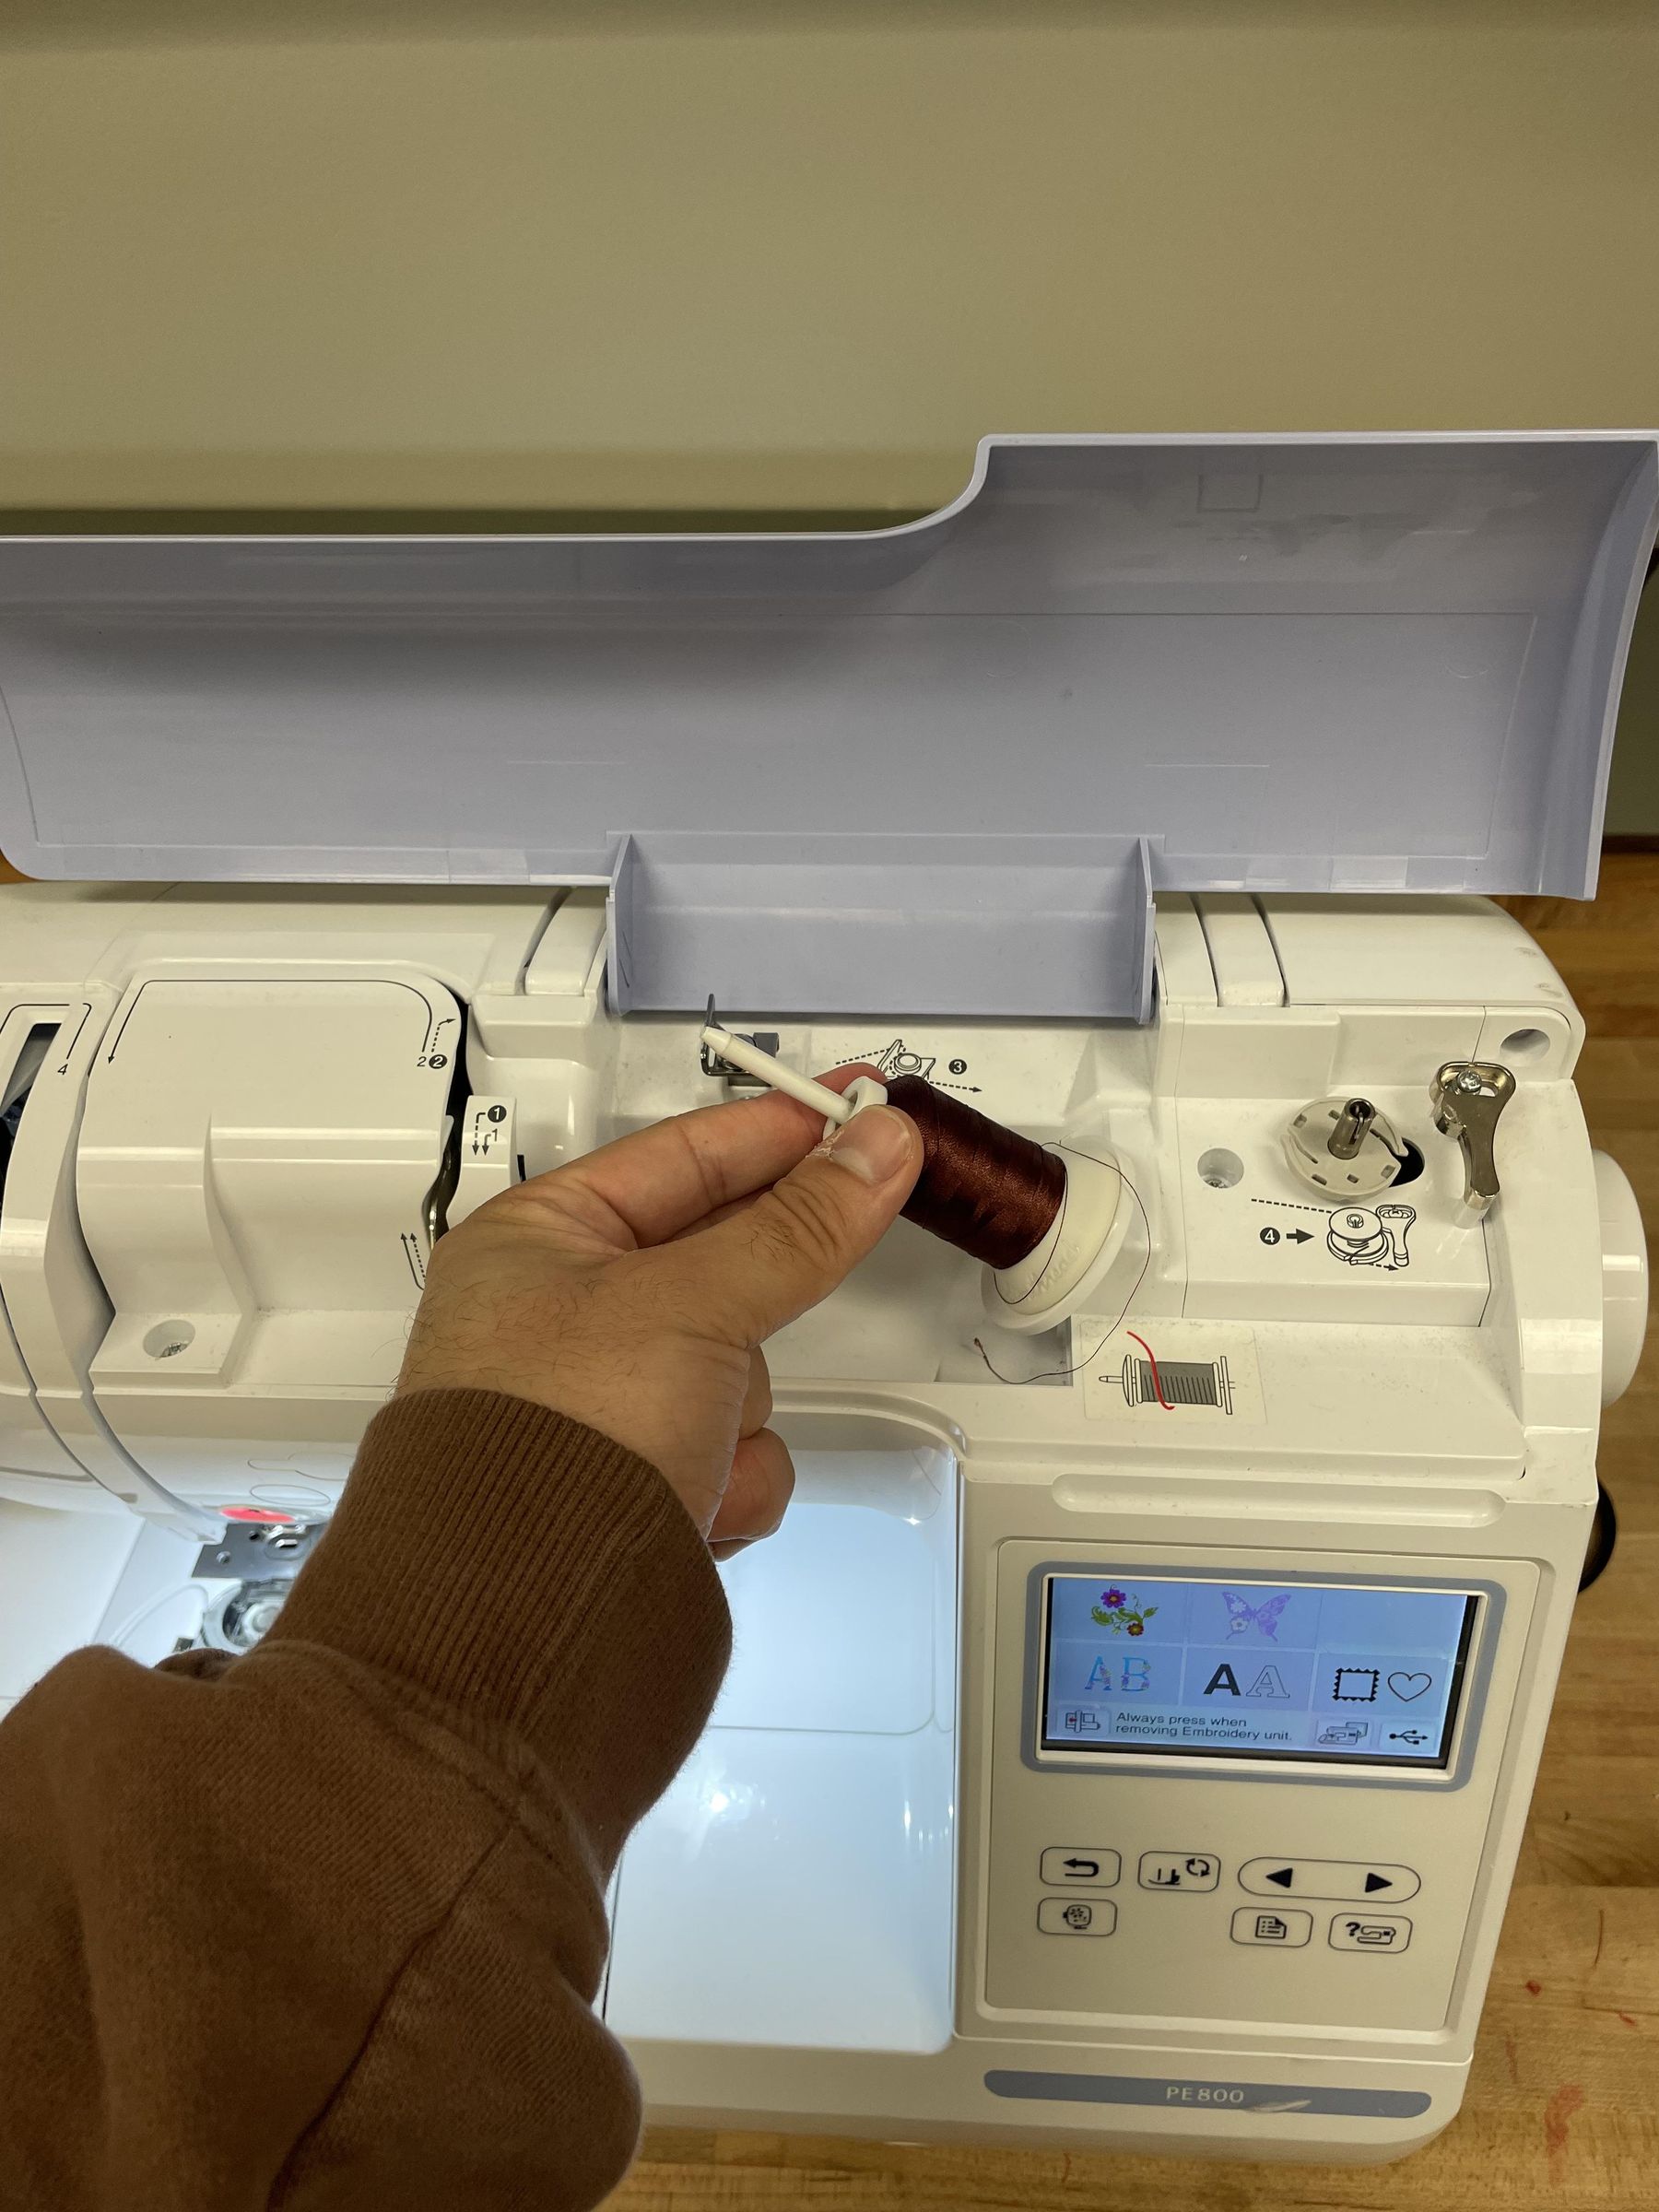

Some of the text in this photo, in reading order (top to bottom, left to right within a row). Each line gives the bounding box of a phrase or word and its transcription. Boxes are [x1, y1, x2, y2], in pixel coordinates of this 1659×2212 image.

[417, 1055, 427, 1067] 2
[57, 1063, 68, 1076] 4
[1116, 1712, 1247, 1728] Always press when
[1115, 1724, 1292, 1741] removing Embroidery unit.
[1165, 2086, 1244, 2104] PE800
